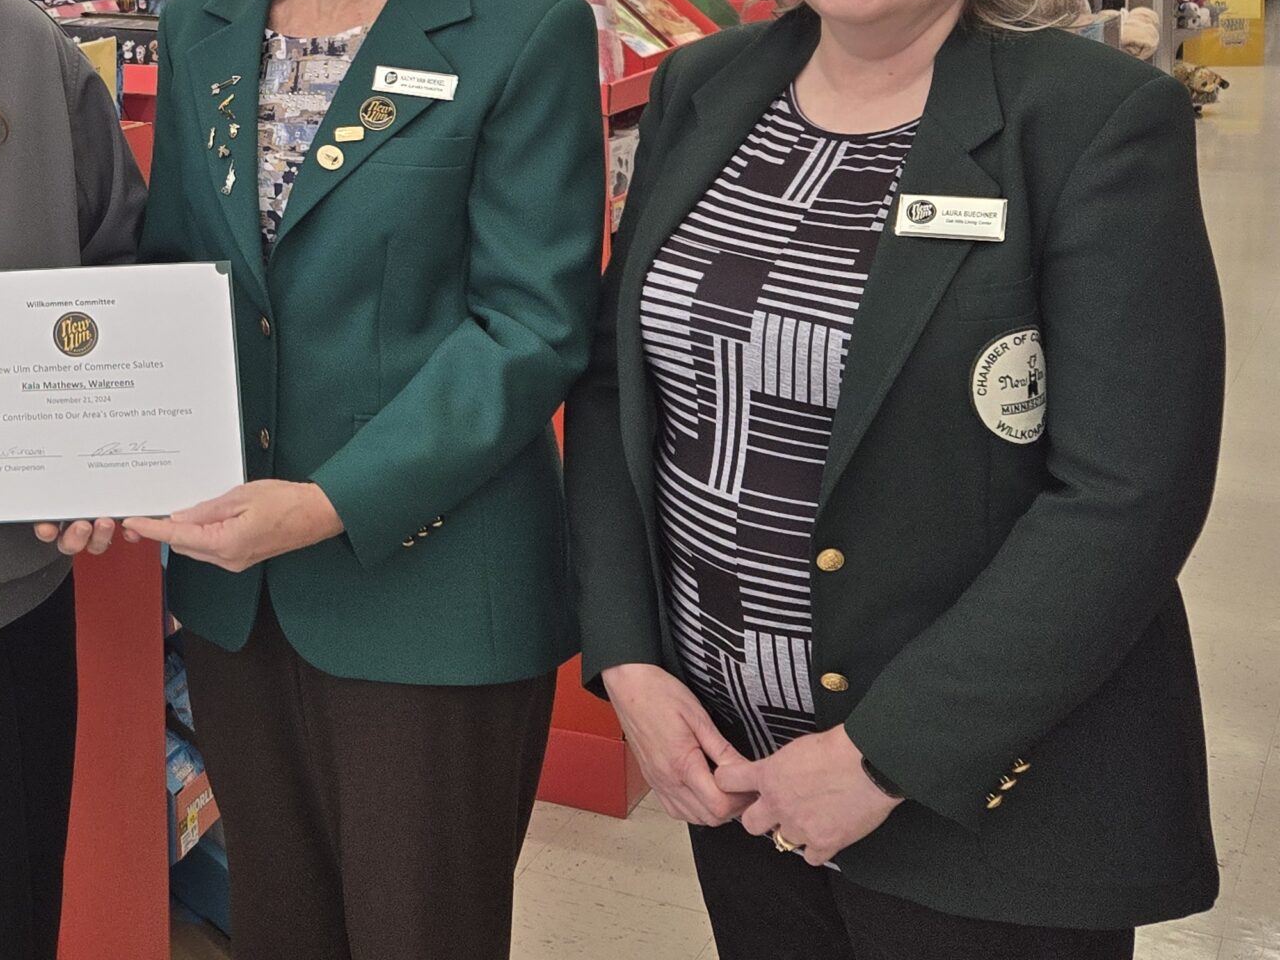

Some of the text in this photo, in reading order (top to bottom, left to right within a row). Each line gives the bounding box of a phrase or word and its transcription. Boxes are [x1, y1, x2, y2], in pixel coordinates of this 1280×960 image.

[941, 209, 962, 217] LAURA
[26, 298, 115, 308] Willkommen Committee
[13, 365, 30, 374] Ulm
[33, 363, 71, 373] Chamber
[74, 363, 83, 371] of
[84, 361, 130, 371] Commerce
[133, 360, 164, 369] Salutes
[977, 334, 1028, 396] CHAMBER OF
[43, 380, 86, 389] Mathews,
[88, 378, 135, 389] Walgreens
[2, 412, 54, 422] Contribution
[55, 412, 63, 420] to
[65, 411, 81, 420] Our
[83, 410, 107, 419] Area's
[109, 409, 140, 418] Growth
[141, 408, 156, 416] and
[158, 407, 193, 417] Progress
[186, 788, 214, 813] WORL
